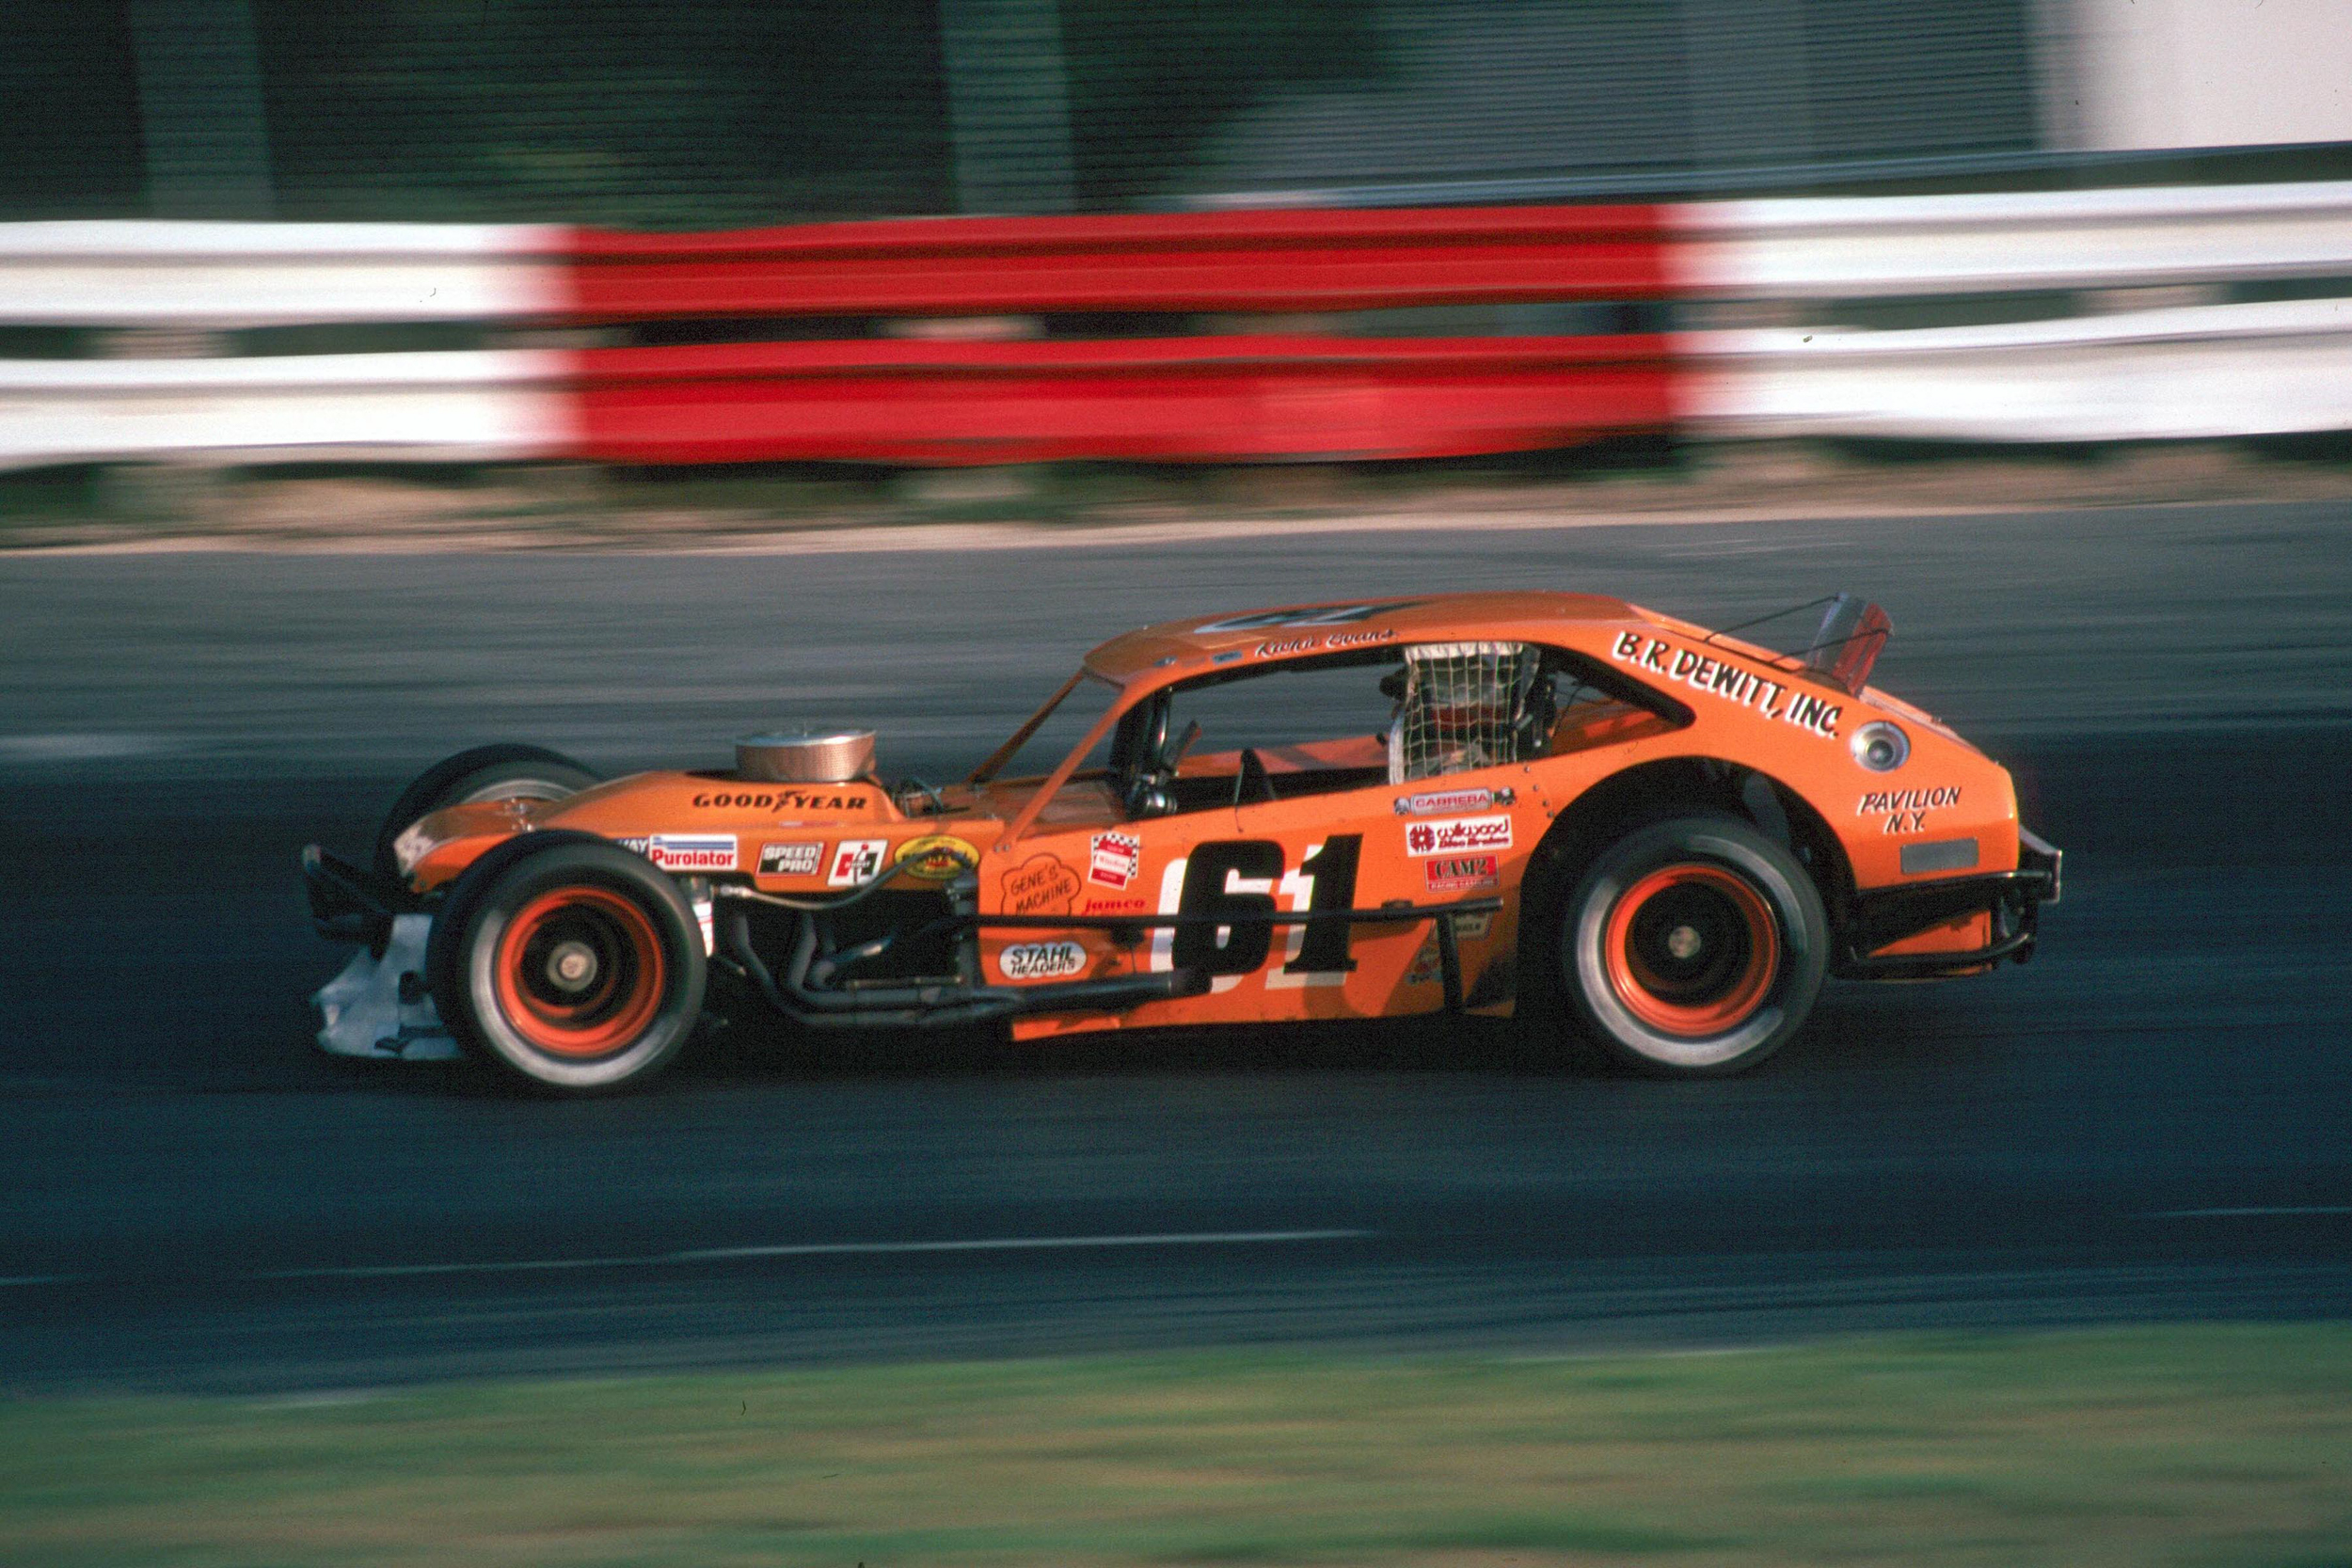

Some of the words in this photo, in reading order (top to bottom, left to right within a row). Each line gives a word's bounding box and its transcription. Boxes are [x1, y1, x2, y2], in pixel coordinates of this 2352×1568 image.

[1669, 649, 1788, 720] DEWITT,
[1785, 691, 1843, 739] INC.
[1856, 786, 1962, 816] PAVILION
[1883, 811, 1926, 835] N.Y.
[651, 848, 734, 863] Purolator
[762, 847, 817, 860] SPEED
[777, 859, 814, 873] PRO
[1435, 857, 1487, 879] CAM2
[1010, 864, 1059, 895] GENE'S
[1016, 879, 1072, 916] MACHINE
[1151, 833, 1363, 993] 61
[1010, 957, 1076, 975] HEADERS
[1011, 945, 1072, 964] STAHL
